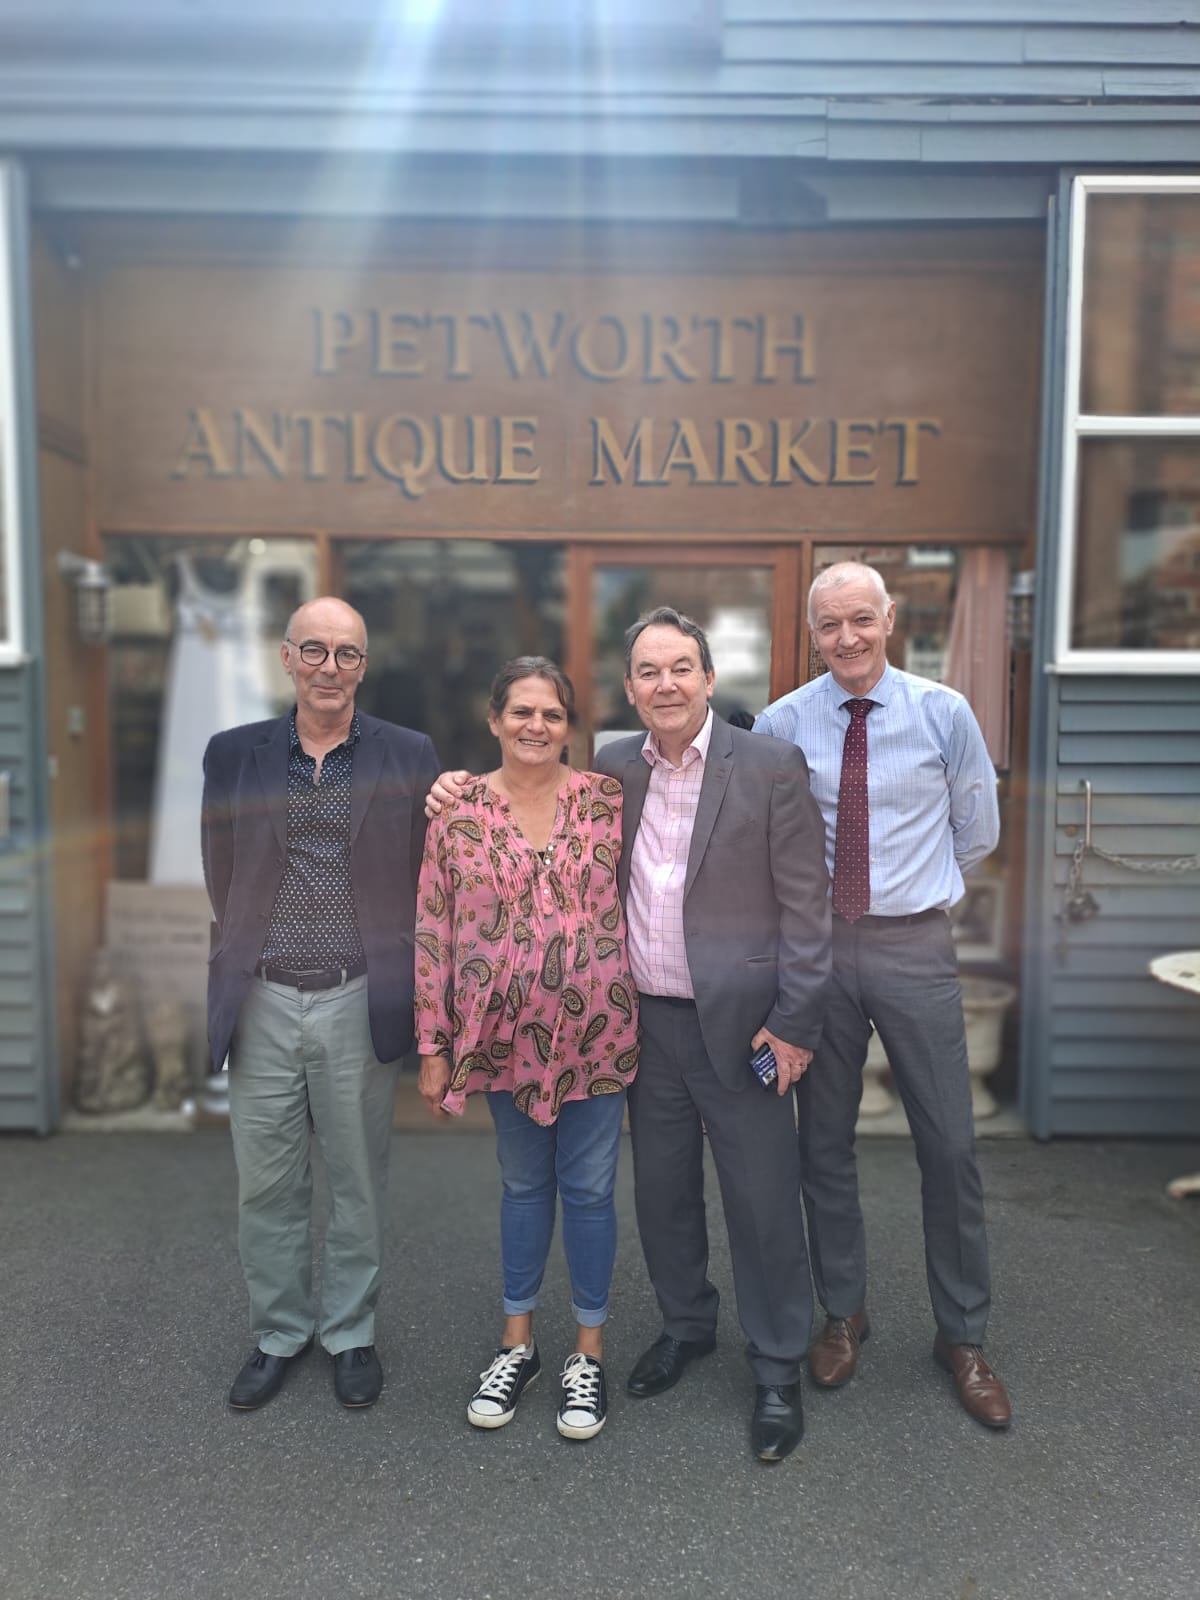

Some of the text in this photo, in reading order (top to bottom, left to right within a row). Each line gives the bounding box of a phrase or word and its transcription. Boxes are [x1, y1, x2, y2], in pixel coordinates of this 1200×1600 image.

[312, 307, 817, 384] PETWORTH
[171, 405, 941, 500] ANTIQUE MARKET
